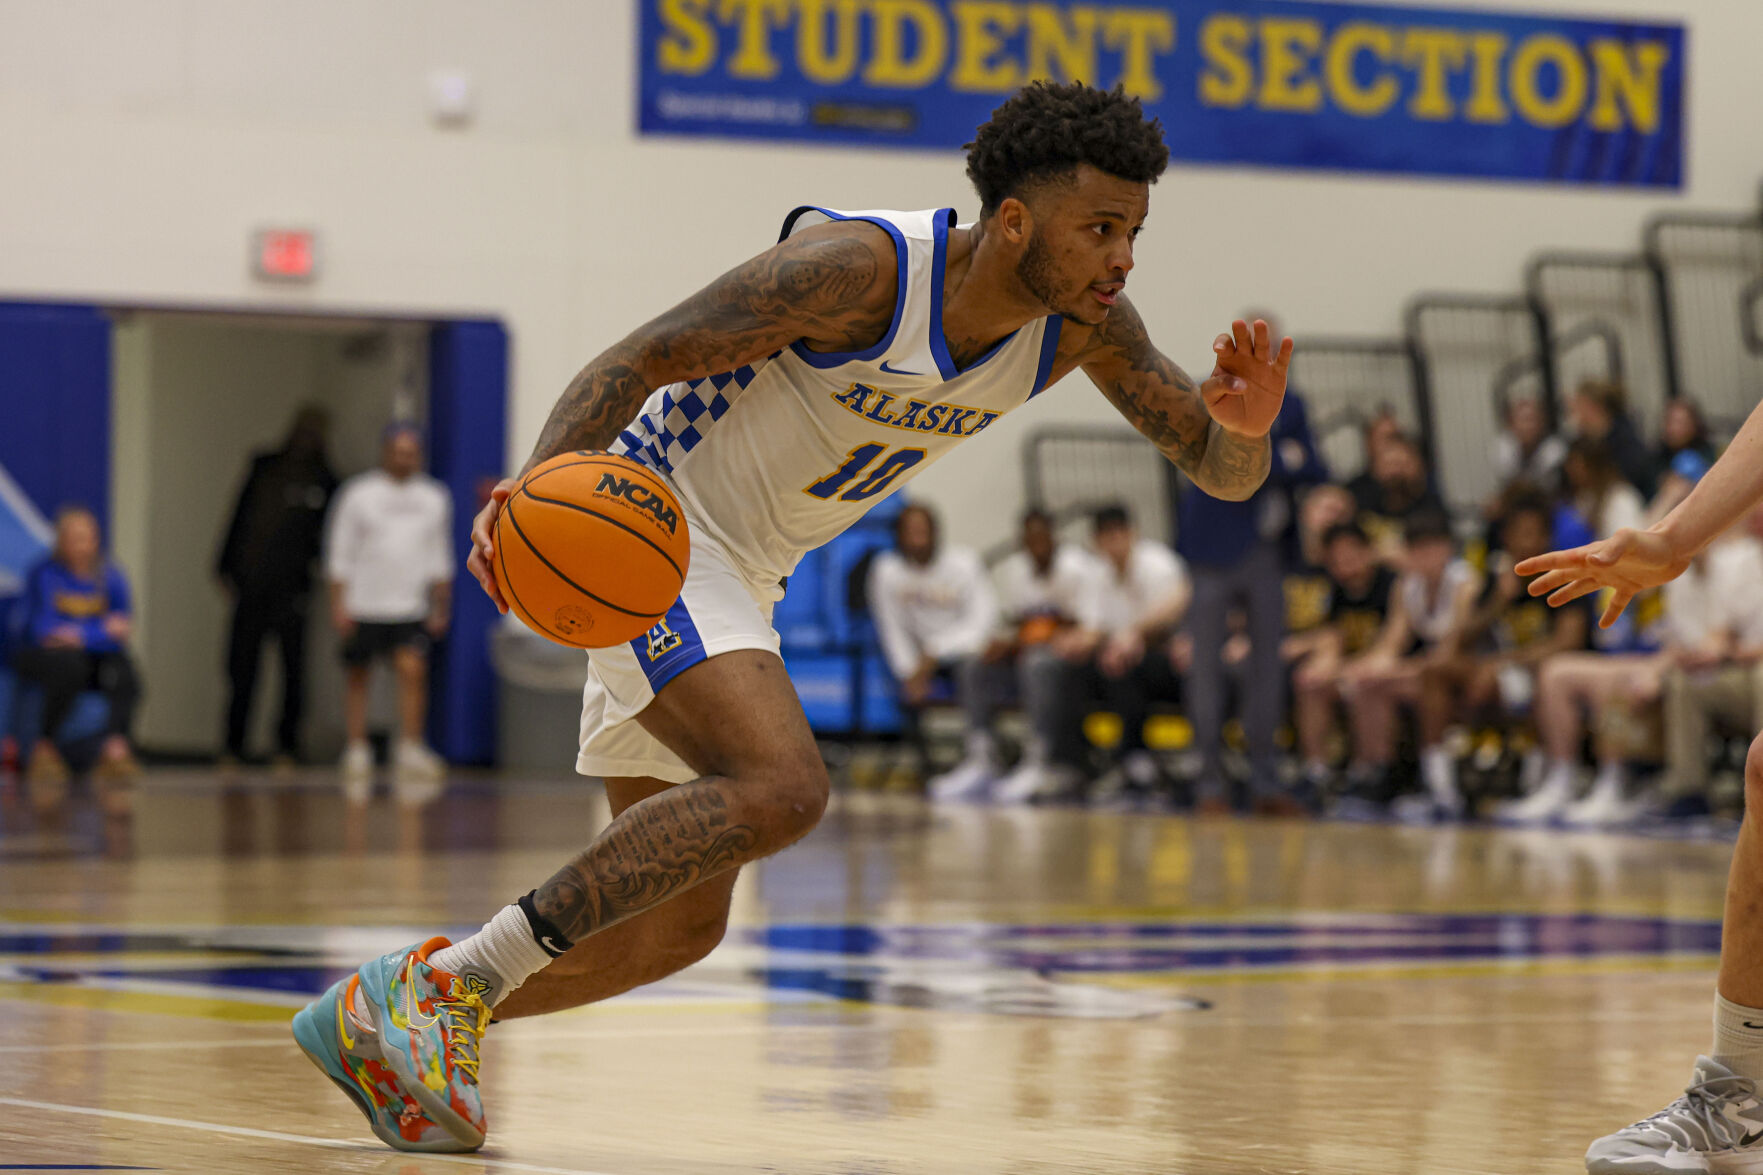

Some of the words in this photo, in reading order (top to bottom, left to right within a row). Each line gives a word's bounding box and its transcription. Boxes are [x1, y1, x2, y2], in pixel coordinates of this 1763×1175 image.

[657, 0, 1175, 100] STUDENT
[1200, 14, 1668, 135] SECTION
[830, 382, 1003, 438] ALASKA
[802, 440, 928, 502] 10
[592, 491, 631, 509] OFFICIAL
[632, 506, 655, 522] GAME
[656, 522, 672, 541] BALL
[595, 472, 678, 535] NCAA
